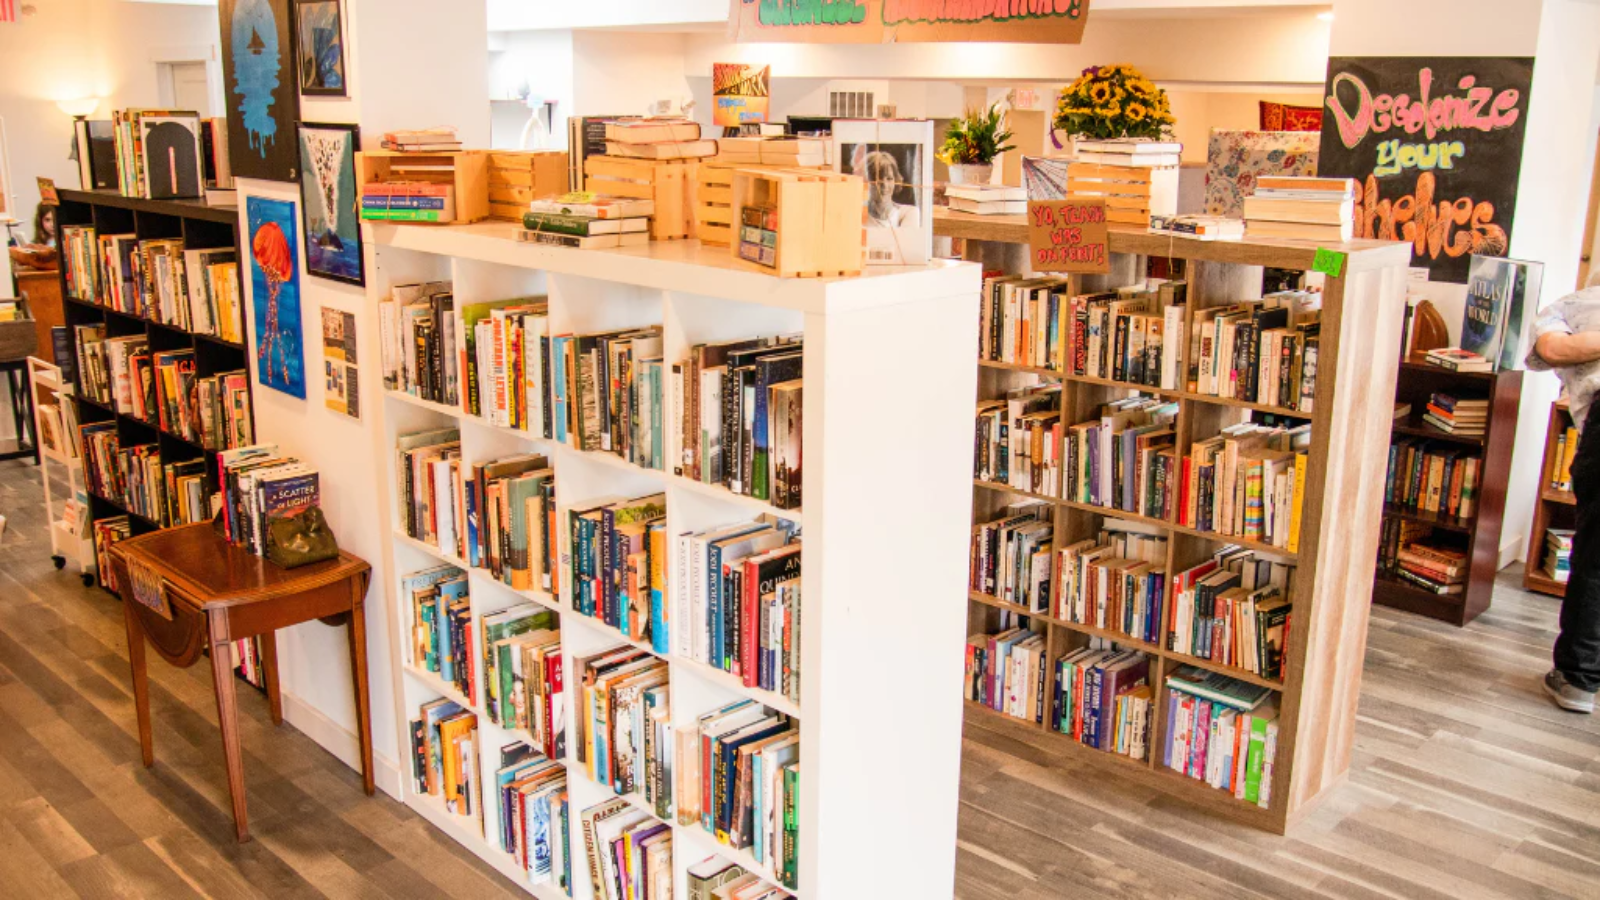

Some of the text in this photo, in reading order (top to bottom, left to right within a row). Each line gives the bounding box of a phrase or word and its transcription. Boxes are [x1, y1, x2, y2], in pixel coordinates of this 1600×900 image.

[1325, 68, 1519, 148] Decolonize
[1373, 138, 1465, 177] your
[1049, 227, 1082, 245] WAS
[1037, 248, 1058, 264] ON
[493, 316, 506, 410] JONATHAN LETHEM
[279, 485, 315, 499] SCATTER
[286, 496, 312, 508] LIGHT
[603, 535, 611, 573] PICOULT
[709, 547, 718, 570] JODI
[692, 566, 701, 606] PICOULT
[709, 572, 718, 613] PICOULT
[582, 820, 594, 852] CITIZEN
